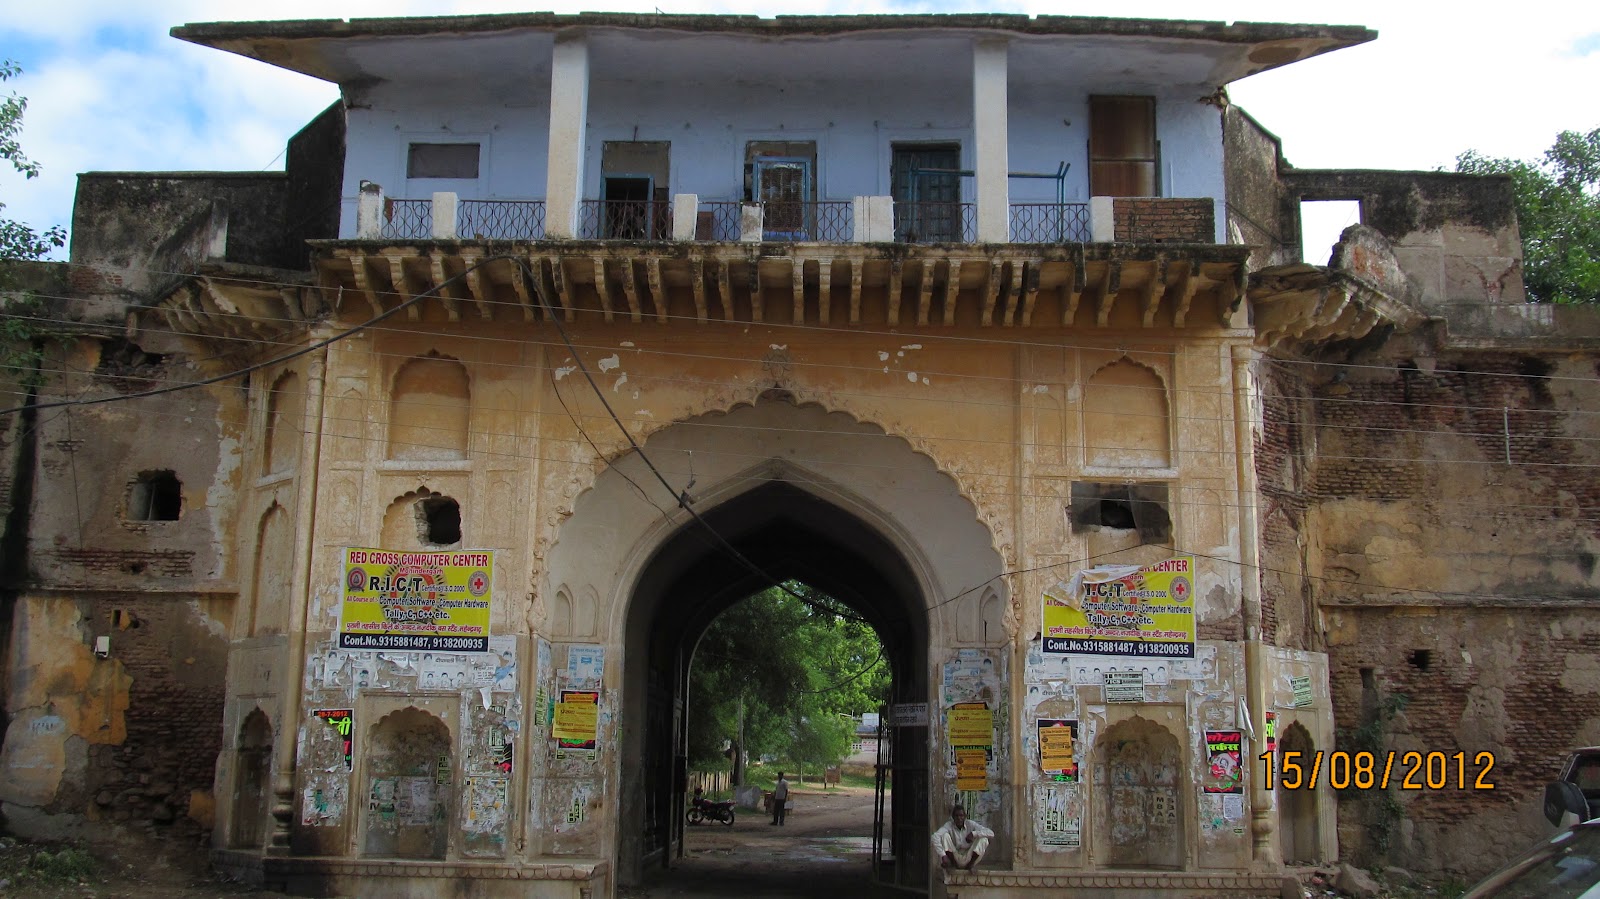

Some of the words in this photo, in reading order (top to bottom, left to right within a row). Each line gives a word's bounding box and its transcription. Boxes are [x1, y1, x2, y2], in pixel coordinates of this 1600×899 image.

[350, 552, 367, 564] RED
[370, 552, 399, 565] CROSS
[401, 554, 450, 567] COMPUTER
[452, 554, 488, 567] CENTER
[370, 576, 422, 592] R.I.C.T
[379, 596, 408, 606] Computer
[440, 598, 463, 610] Computer
[463, 599, 489, 608] Hardware
[1141, 603, 1166, 615] Computer
[1167, 604, 1191, 614] Hardware
[434, 611, 450, 619] etc.
[1138, 616, 1154, 625] etc.
[433, 637, 483, 649] 9138200935
[1138, 643, 1189, 655] 9138200935
